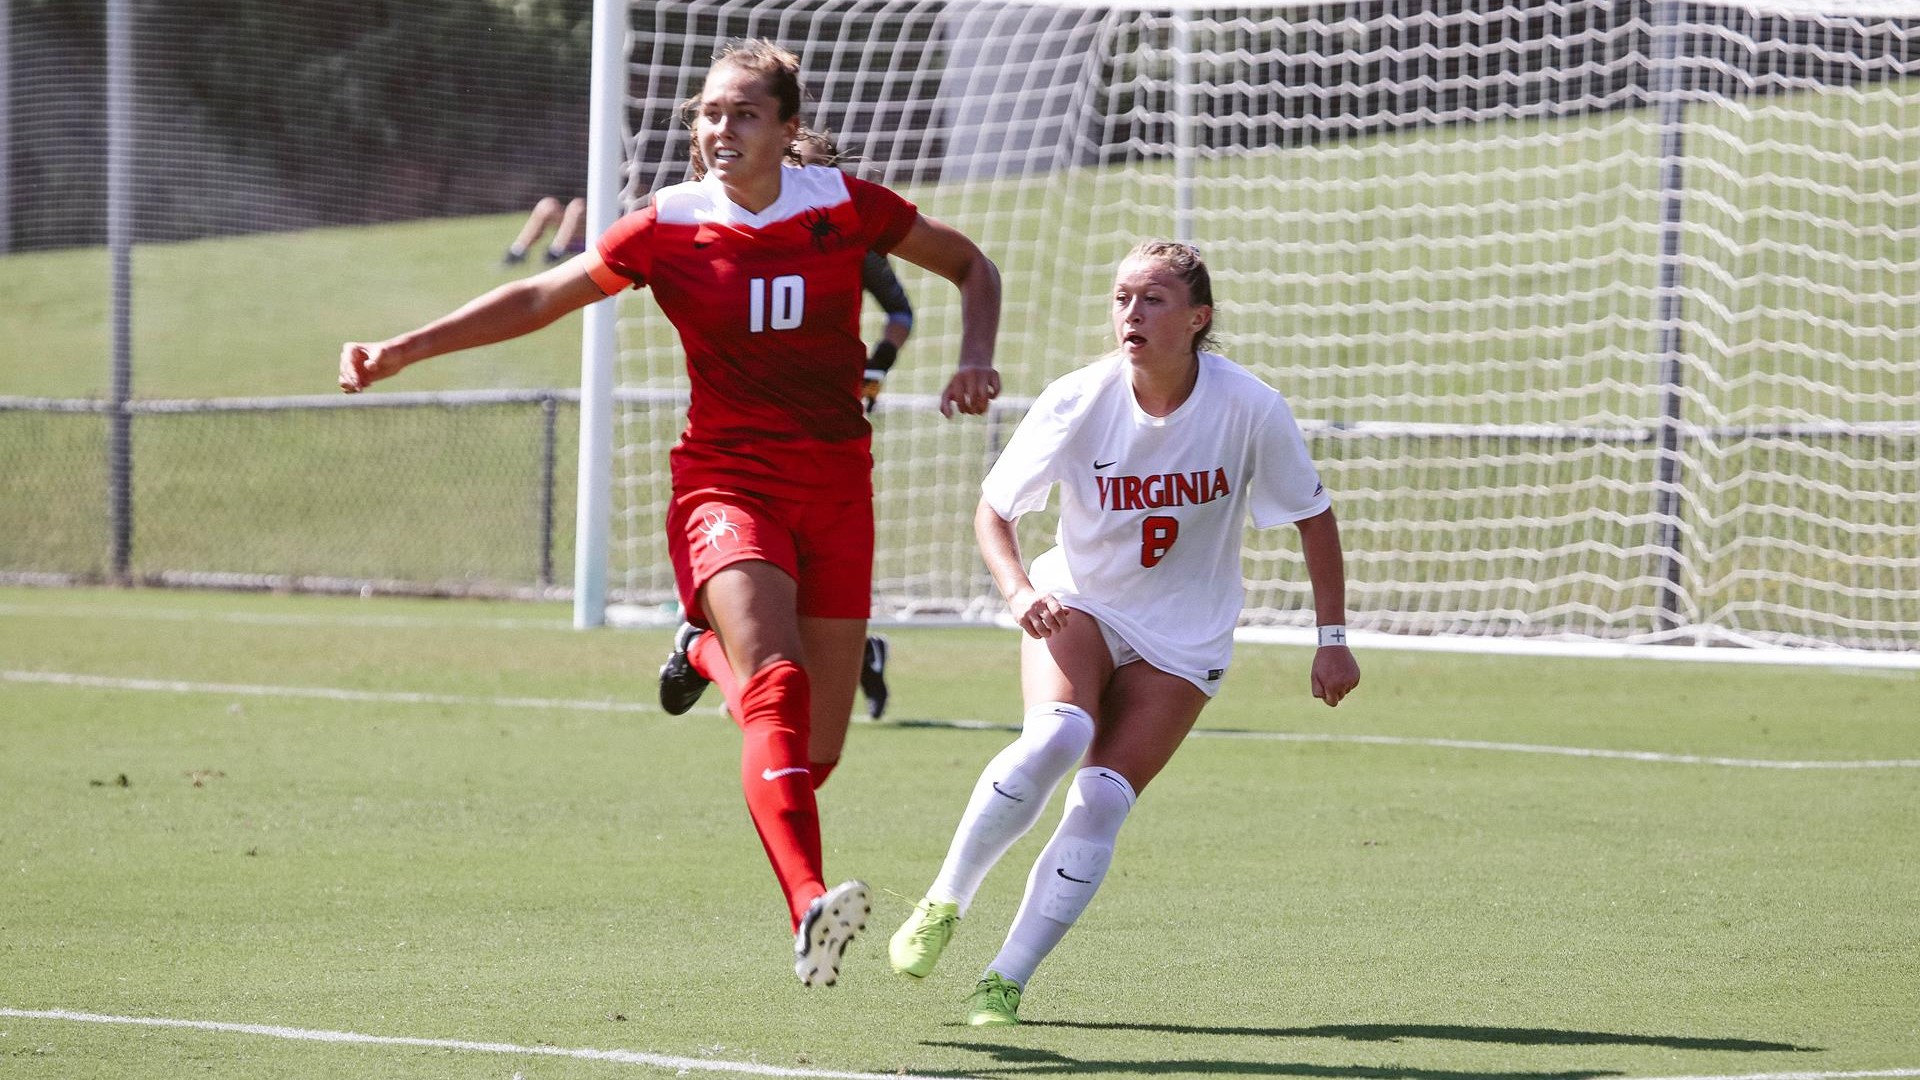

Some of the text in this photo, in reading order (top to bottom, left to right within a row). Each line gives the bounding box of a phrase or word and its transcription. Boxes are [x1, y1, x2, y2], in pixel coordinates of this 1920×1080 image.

[748, 273, 806, 334] 10
[1095, 466, 1231, 511] VIRGINIA
[1141, 515, 1179, 569] 8
